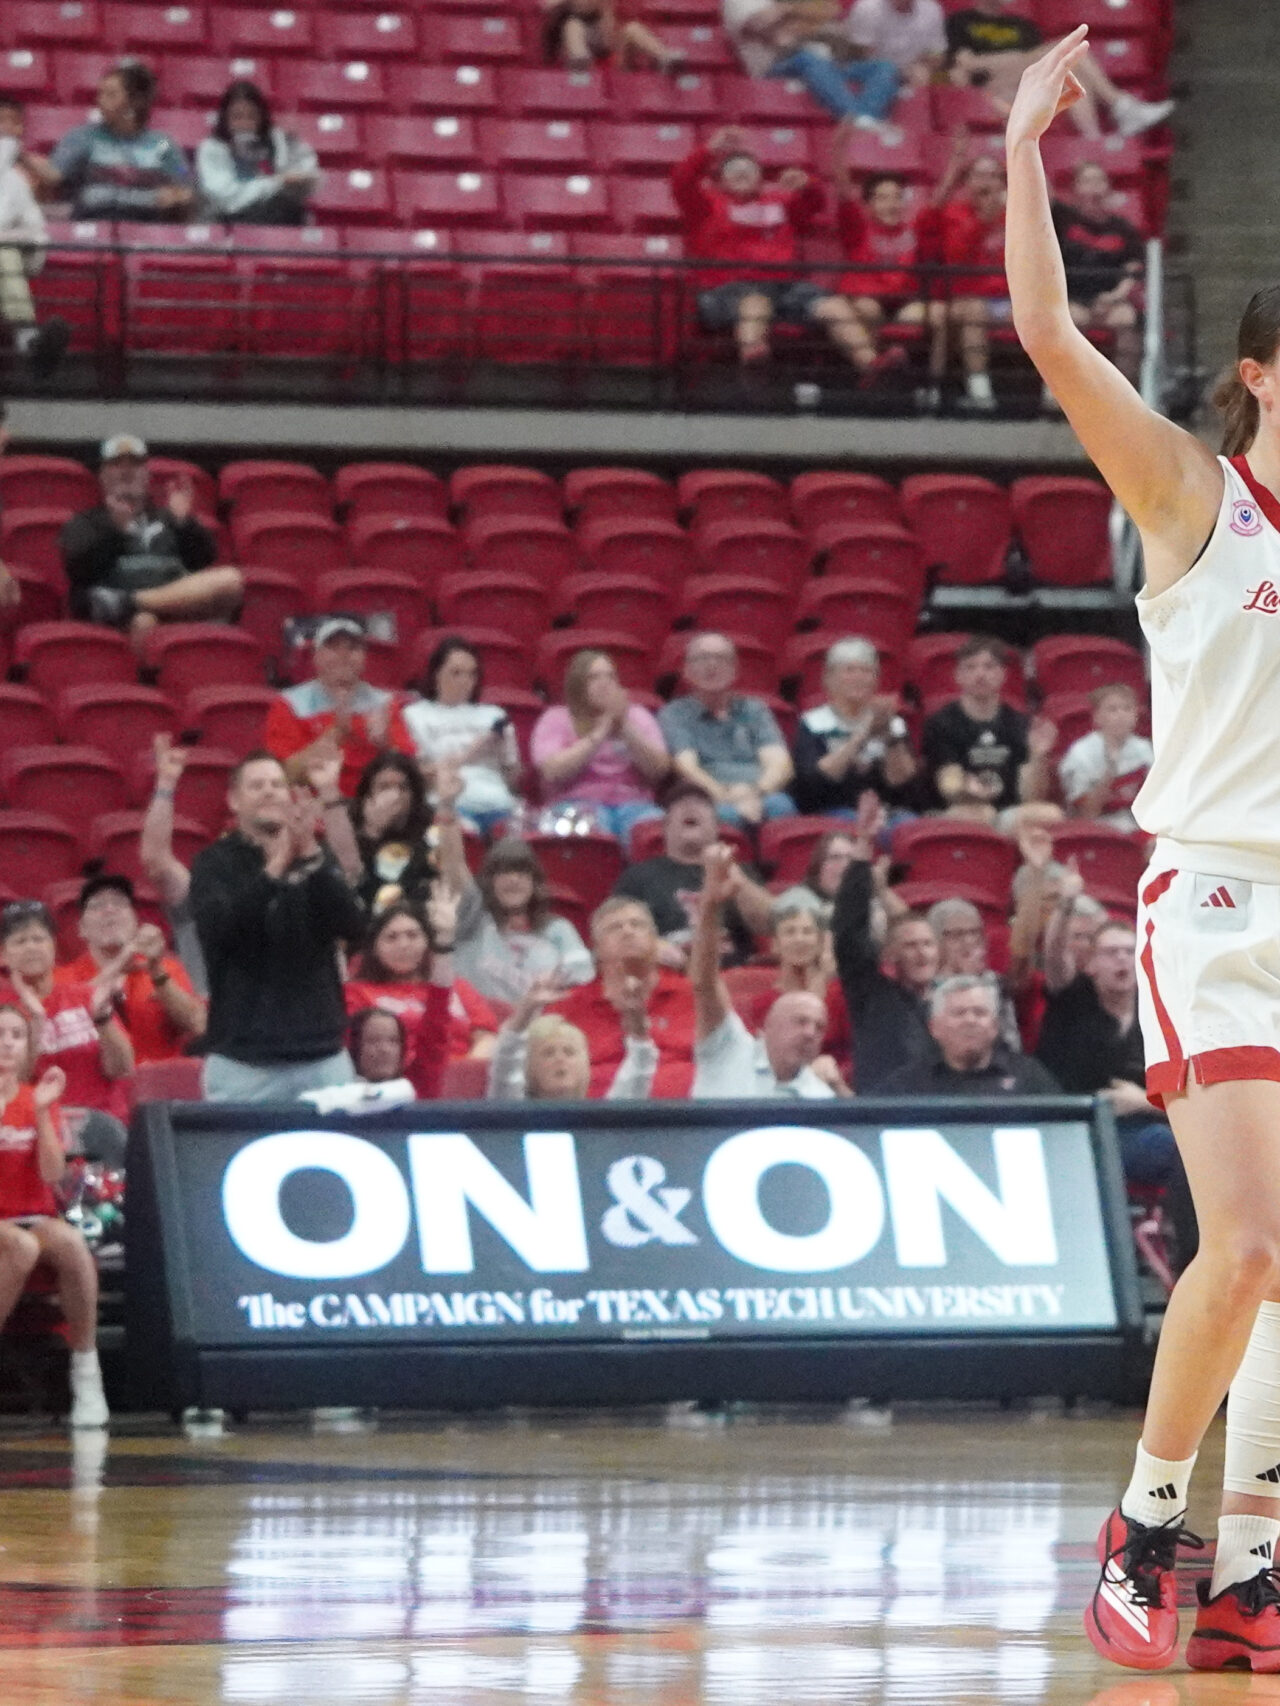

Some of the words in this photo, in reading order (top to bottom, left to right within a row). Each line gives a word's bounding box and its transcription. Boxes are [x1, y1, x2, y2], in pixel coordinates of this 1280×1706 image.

[222, 1131, 589, 1279] ON
[600, 1155, 698, 1247] &
[703, 1126, 1058, 1272] ON
[238, 1292, 306, 1328] The
[310, 1291, 525, 1327] CAMPAIGN
[530, 1288, 584, 1323] for
[587, 1288, 723, 1322] TEXAS
[724, 1287, 833, 1320] TECH
[838, 1284, 1065, 1319] UNIVERSITY
